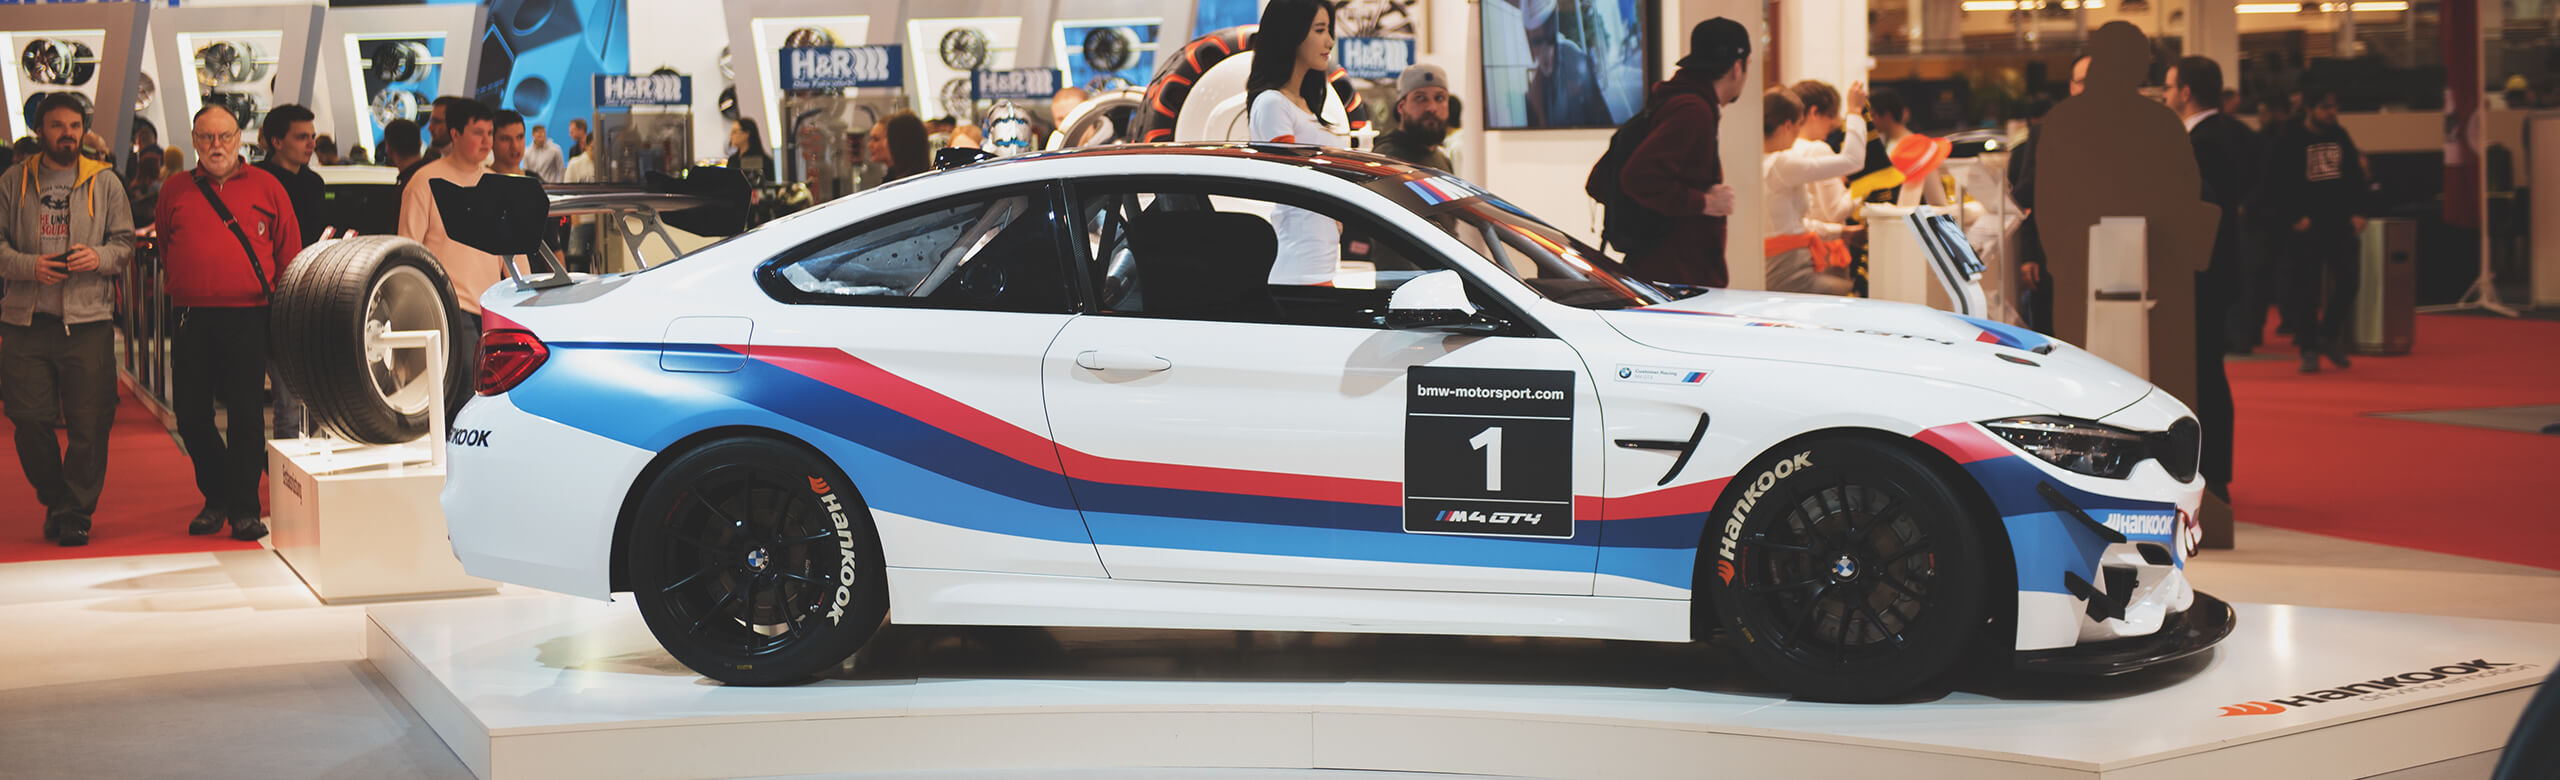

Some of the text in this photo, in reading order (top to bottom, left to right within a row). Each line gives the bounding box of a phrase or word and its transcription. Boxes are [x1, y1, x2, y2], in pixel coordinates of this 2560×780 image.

[792, 49, 853, 80] H&R
[1344, 40, 1388, 69] H&R
[605, 76, 653, 99] H&R
[979, 71, 1025, 93] H&R
[1417, 384, 1564, 400] bmw-motorsport.com
[1469, 427, 1502, 491] 1
[1449, 510, 1542, 525] M4 GT4
